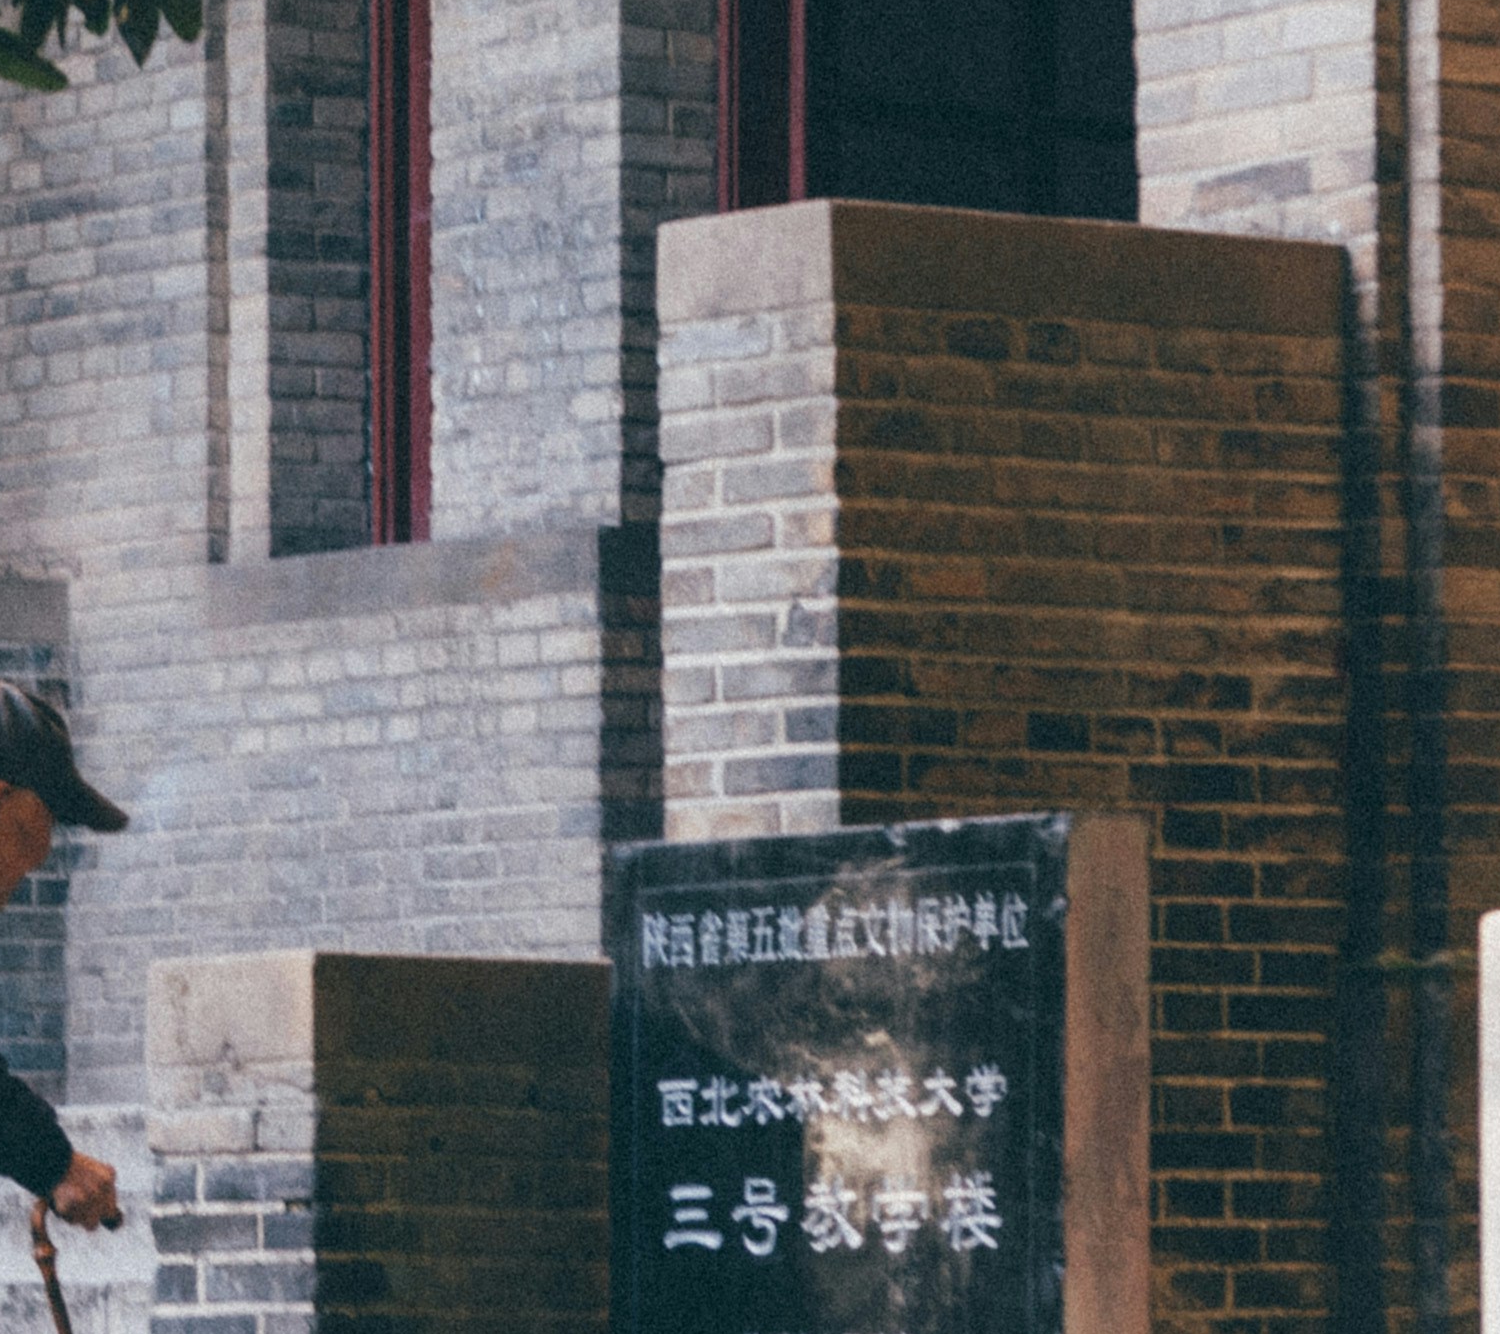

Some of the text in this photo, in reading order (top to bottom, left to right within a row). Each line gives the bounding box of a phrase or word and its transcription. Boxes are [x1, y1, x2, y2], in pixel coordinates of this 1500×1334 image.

[657, 1063, 1007, 1128] 西北农林科技大学
[664, 1171, 1002, 1255] 三号教学楼
